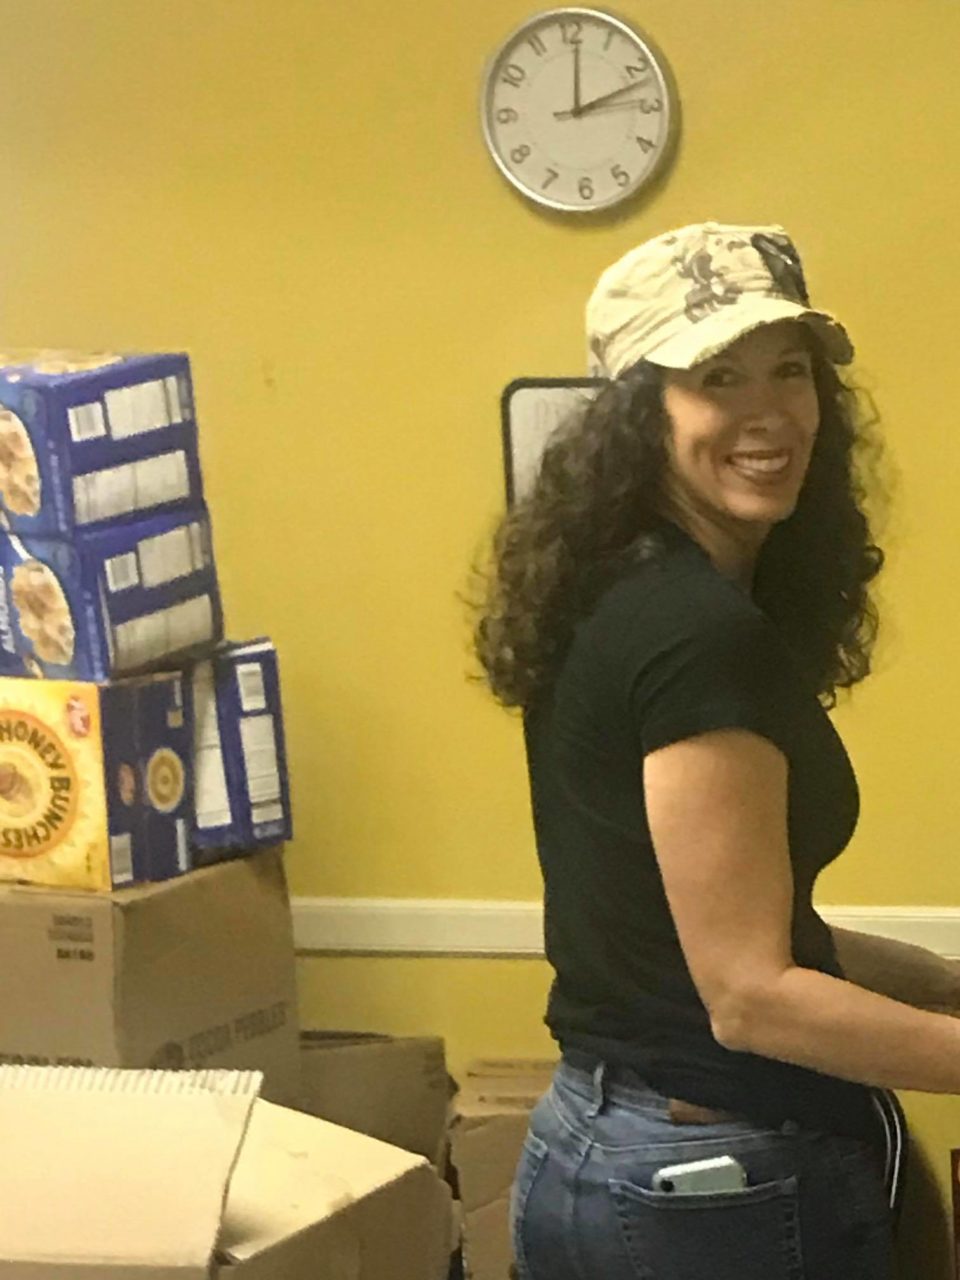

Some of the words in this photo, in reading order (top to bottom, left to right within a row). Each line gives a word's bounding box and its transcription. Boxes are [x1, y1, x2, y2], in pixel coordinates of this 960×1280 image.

[527, 33, 547, 56] 11
[558, 22, 582, 45] 12
[603, 31, 613, 51] 1
[503, 64, 526, 88] 10
[626, 58, 649, 78] 2
[496, 108, 518, 124] 9
[639, 99, 663, 114] 3
[510, 144, 531, 164] 8
[636, 136, 657, 154] 4
[541, 168, 558, 190] 7
[611, 164, 630, 187] 5
[578, 177, 594, 200] 6
[0, 720, 67, 771] HONEY
[2, 776, 71, 850] BUNCHES
